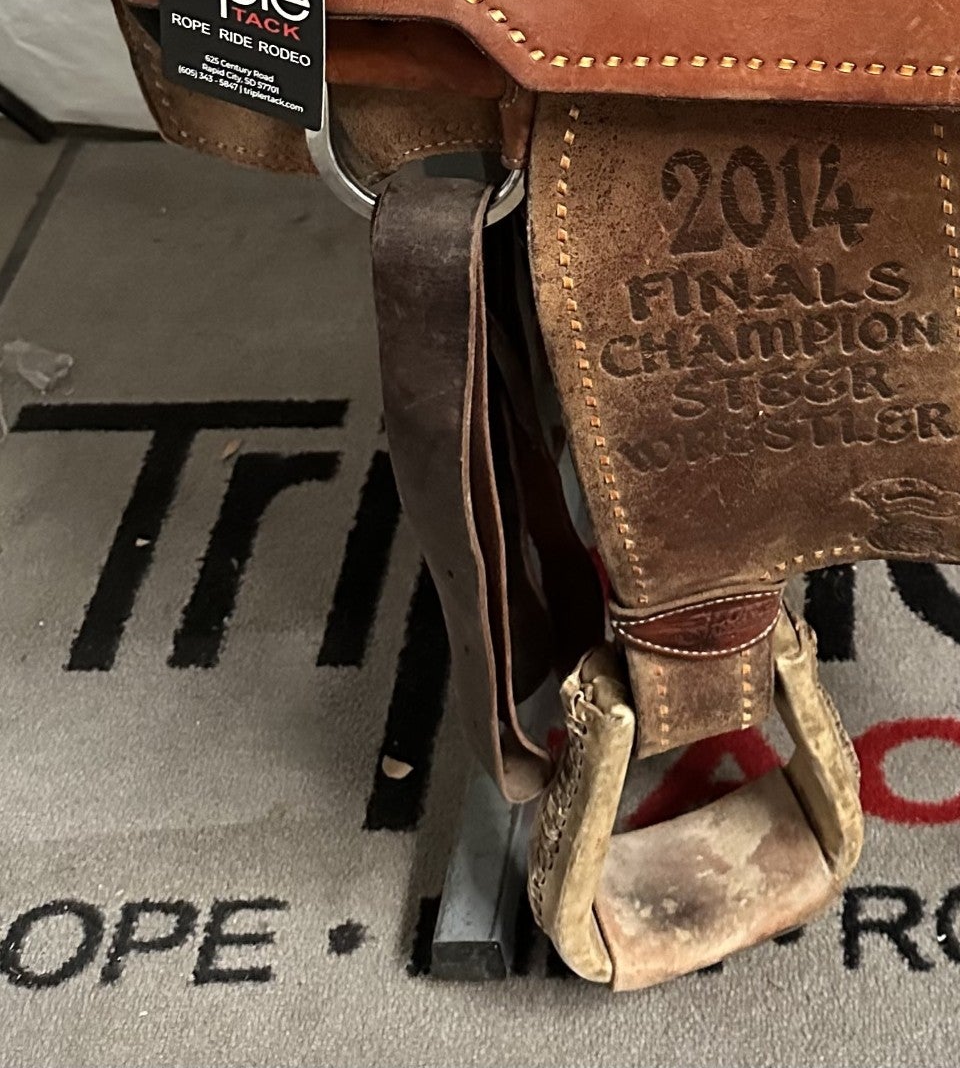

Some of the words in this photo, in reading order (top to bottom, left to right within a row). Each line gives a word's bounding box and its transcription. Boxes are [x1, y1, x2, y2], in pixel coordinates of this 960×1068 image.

[171, 12, 211, 36] ROPE
[219, 28, 253, 49] RIDE
[258, 40, 311, 67] RODEO
[231, 6, 300, 41] TACK
[178, 65, 198, 79] (605)
[199, 72, 214, 83] 343
[219, 78, 239, 91] 5847
[243, 87, 304, 113] triplertack.com
[201, 63, 225, 77] Rapid
[244, 77, 256, 87] SD
[257, 81, 280, 95] 57701
[204, 54, 220, 65] 625
[220, 59, 252, 76] Century
[253, 70, 275, 83] Road
[661, 143, 875, 256] 2014
[624, 261, 912, 324] FINALS
[600, 310, 942, 379] CHAMPION
[672, 361, 899, 419] STEER
